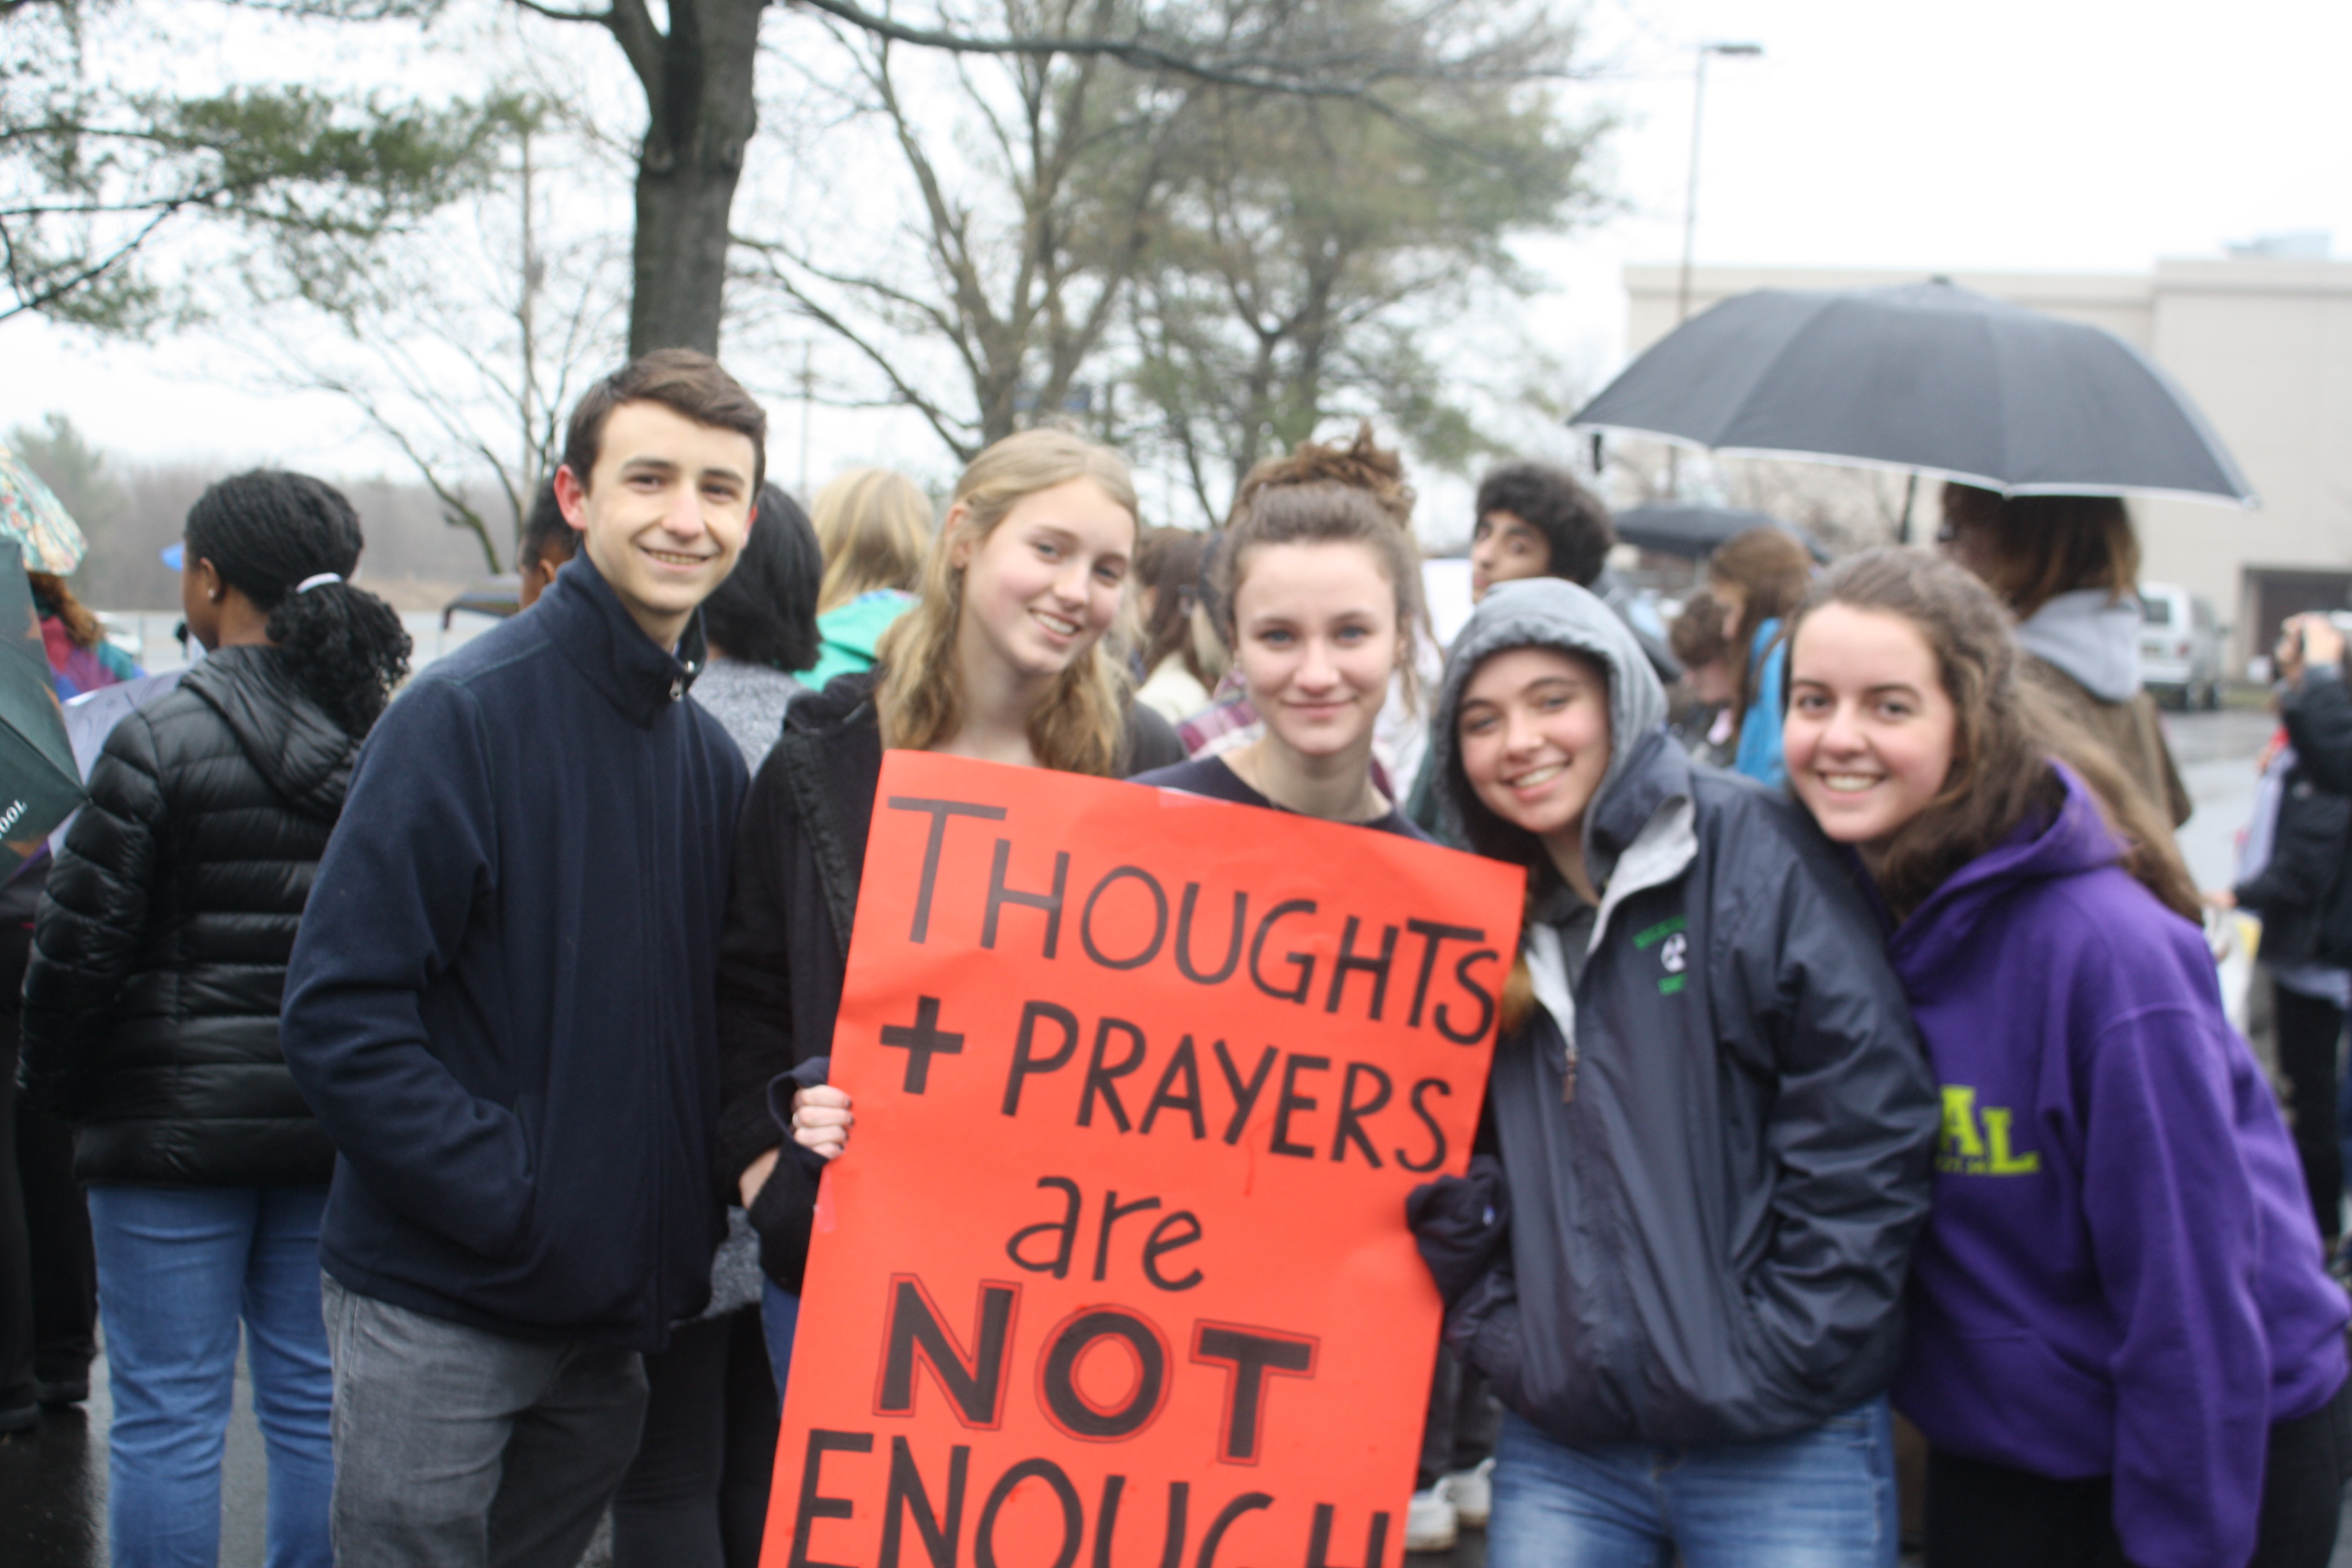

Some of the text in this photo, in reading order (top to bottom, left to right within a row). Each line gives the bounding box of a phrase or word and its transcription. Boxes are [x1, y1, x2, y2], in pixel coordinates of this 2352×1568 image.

[0, 799, 28, 840] OOL
[886, 794, 1499, 1046] THOUGHTS
[879, 994, 1452, 1174] + PRAYERS
[1005, 1176, 1204, 1293] are
[873, 1273, 1320, 1466] NOT
